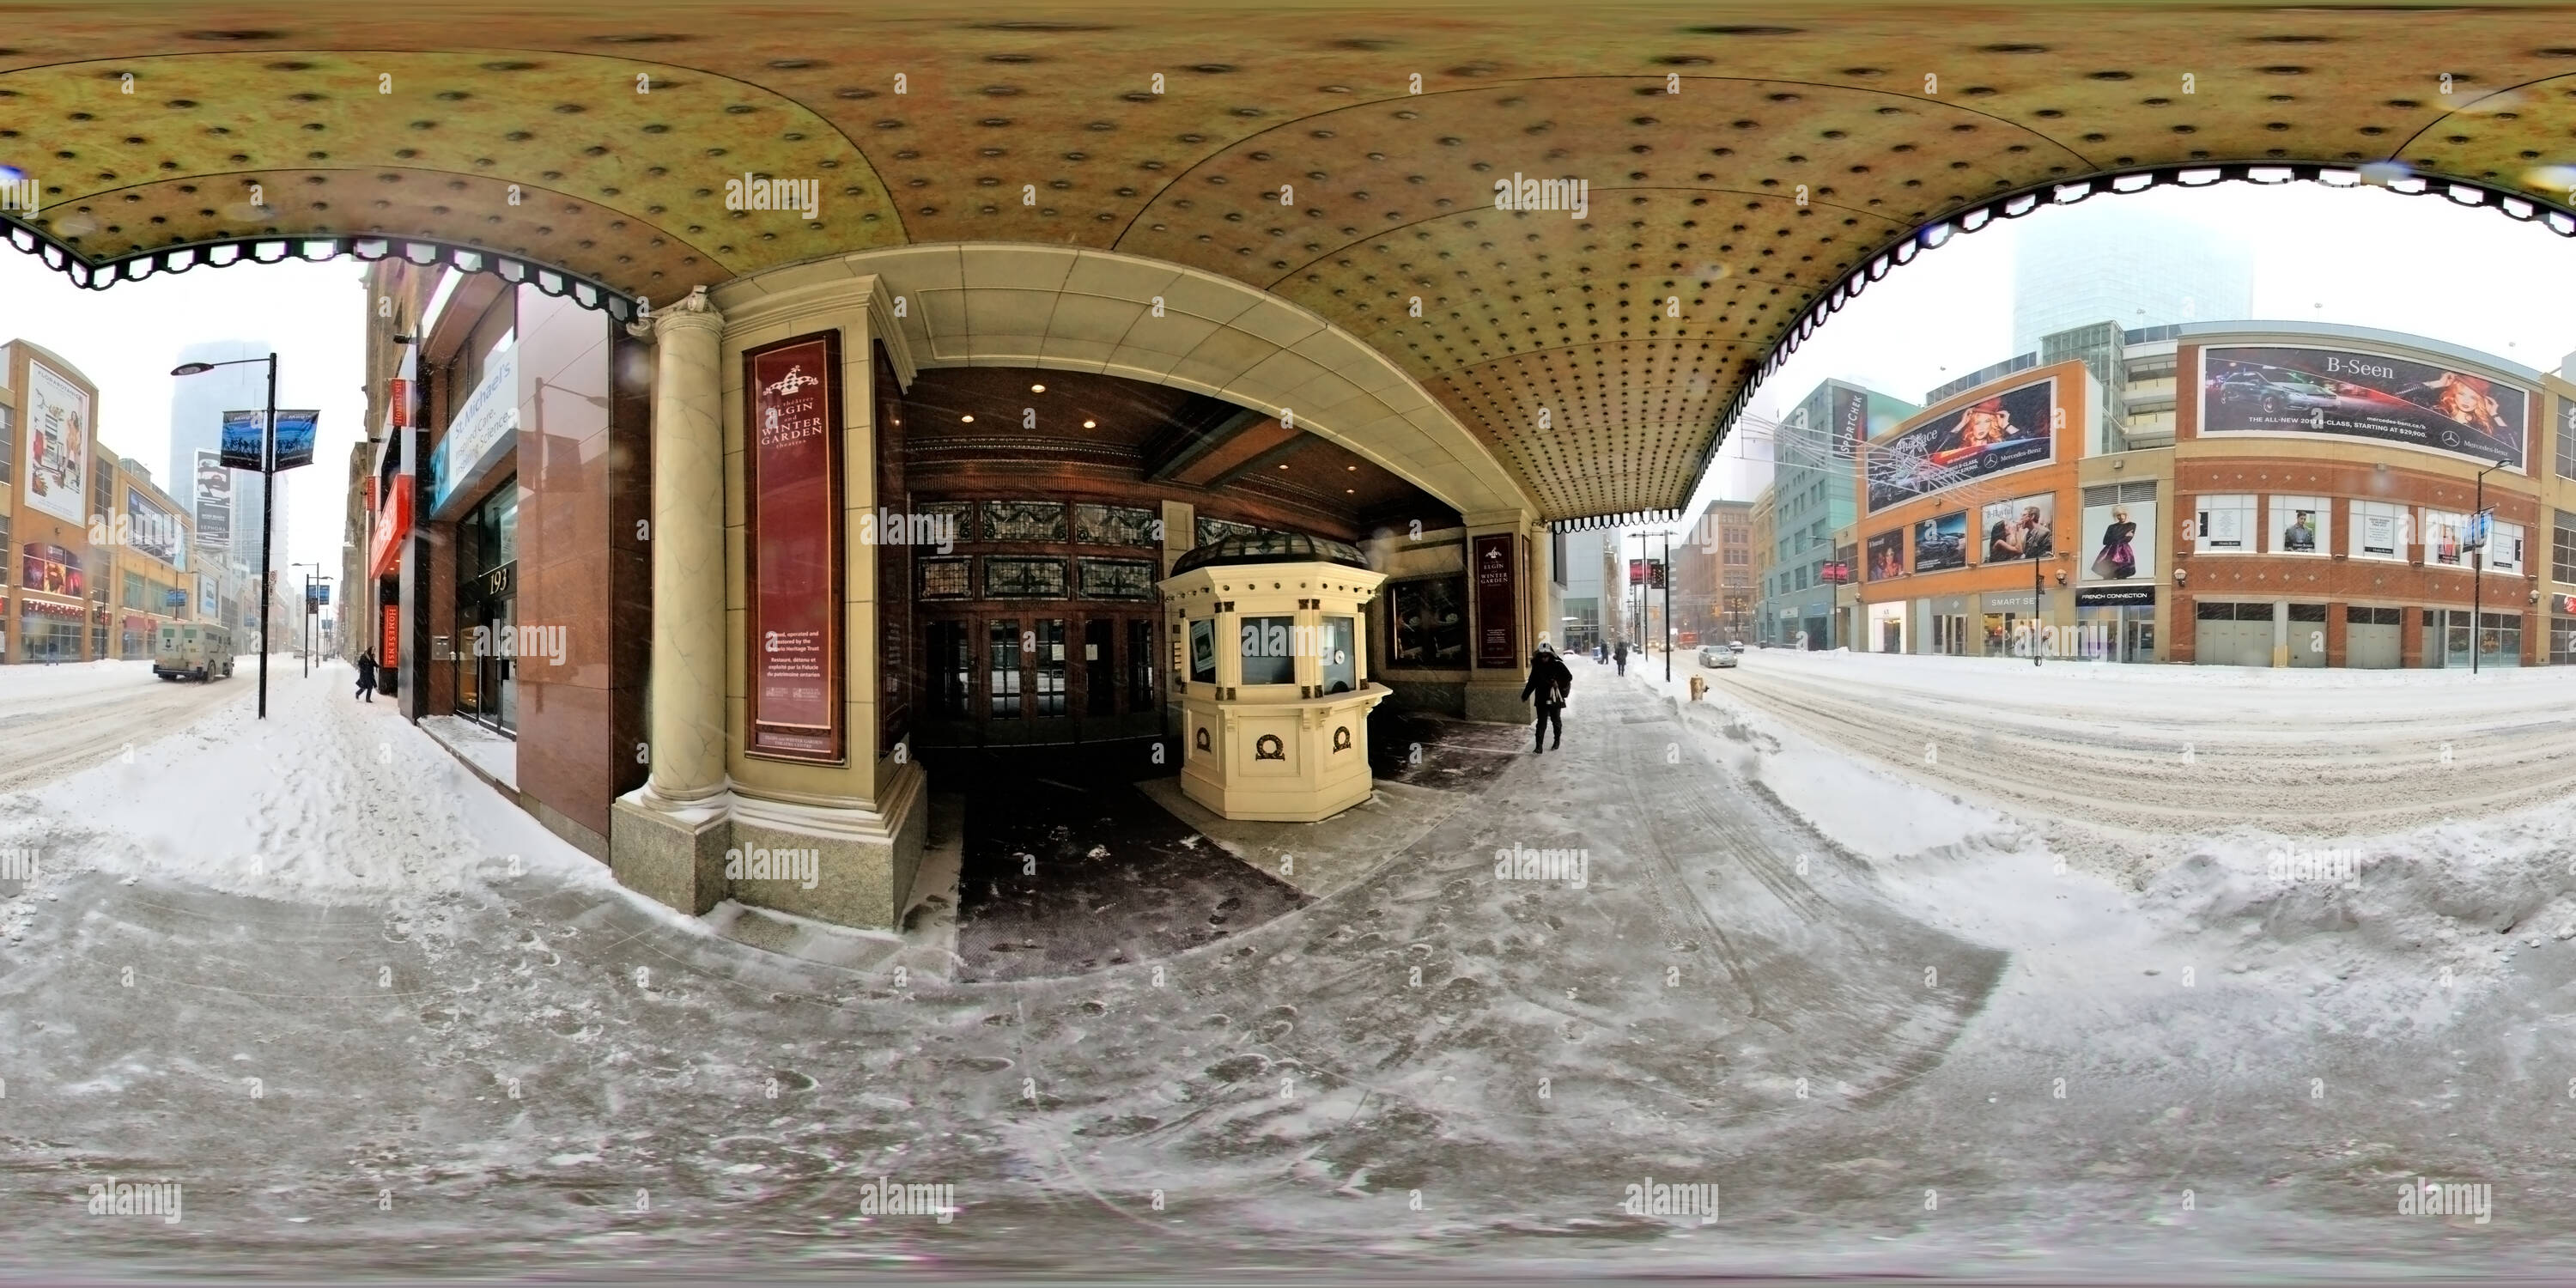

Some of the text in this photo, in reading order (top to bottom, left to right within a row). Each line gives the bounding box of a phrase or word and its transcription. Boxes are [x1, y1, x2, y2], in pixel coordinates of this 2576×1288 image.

[2327, 357, 2394, 380] B-Seen
[455, 361, 510, 440] St. Michael's
[768, 402, 812, 418] ELGIN
[477, 409, 496, 434] Care.
[762, 417, 822, 436] WINTER
[2354, 422, 2388, 431] STARTING
[2400, 428, 2427, 438] $29,900.
[762, 426, 822, 445] GARDEN
[2001, 447, 2042, 462] Mercedes-Benz
[2464, 440, 2508, 456] Mercedes-Benz
[489, 568, 507, 594] 193
[388, 608, 397, 665] HOMESENSE
